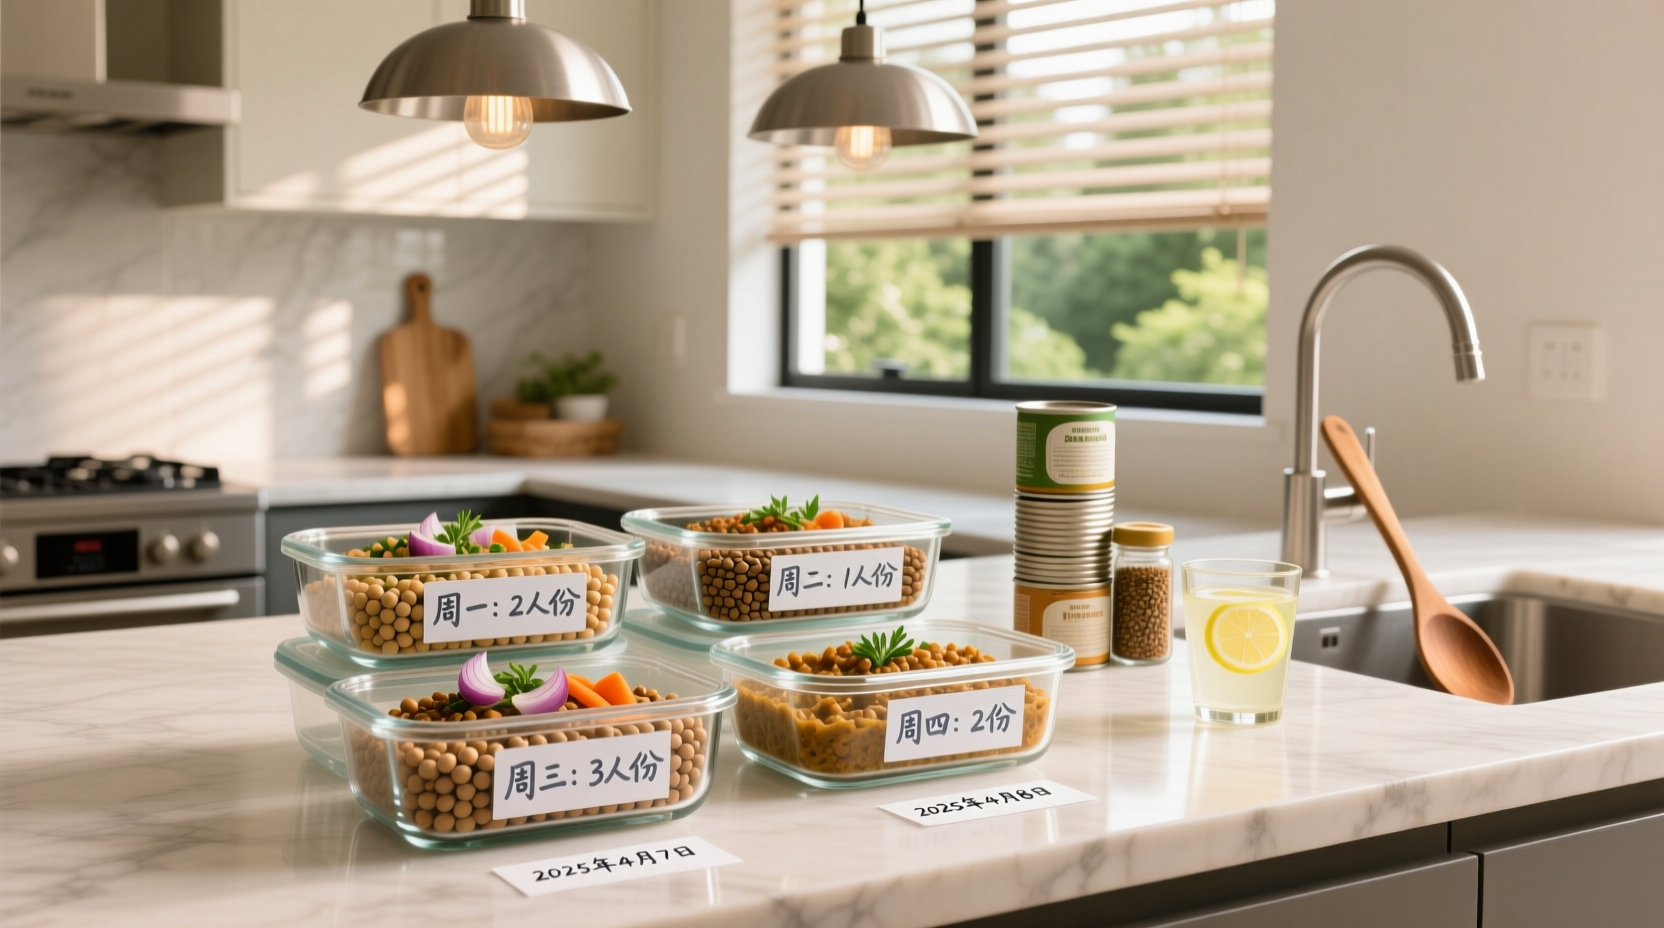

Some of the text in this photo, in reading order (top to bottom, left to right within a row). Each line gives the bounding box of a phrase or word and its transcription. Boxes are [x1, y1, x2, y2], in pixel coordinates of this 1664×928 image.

[914, 786, 1052, 817] 2025年4月8日
[532, 845, 696, 882] 2025年4月7日
